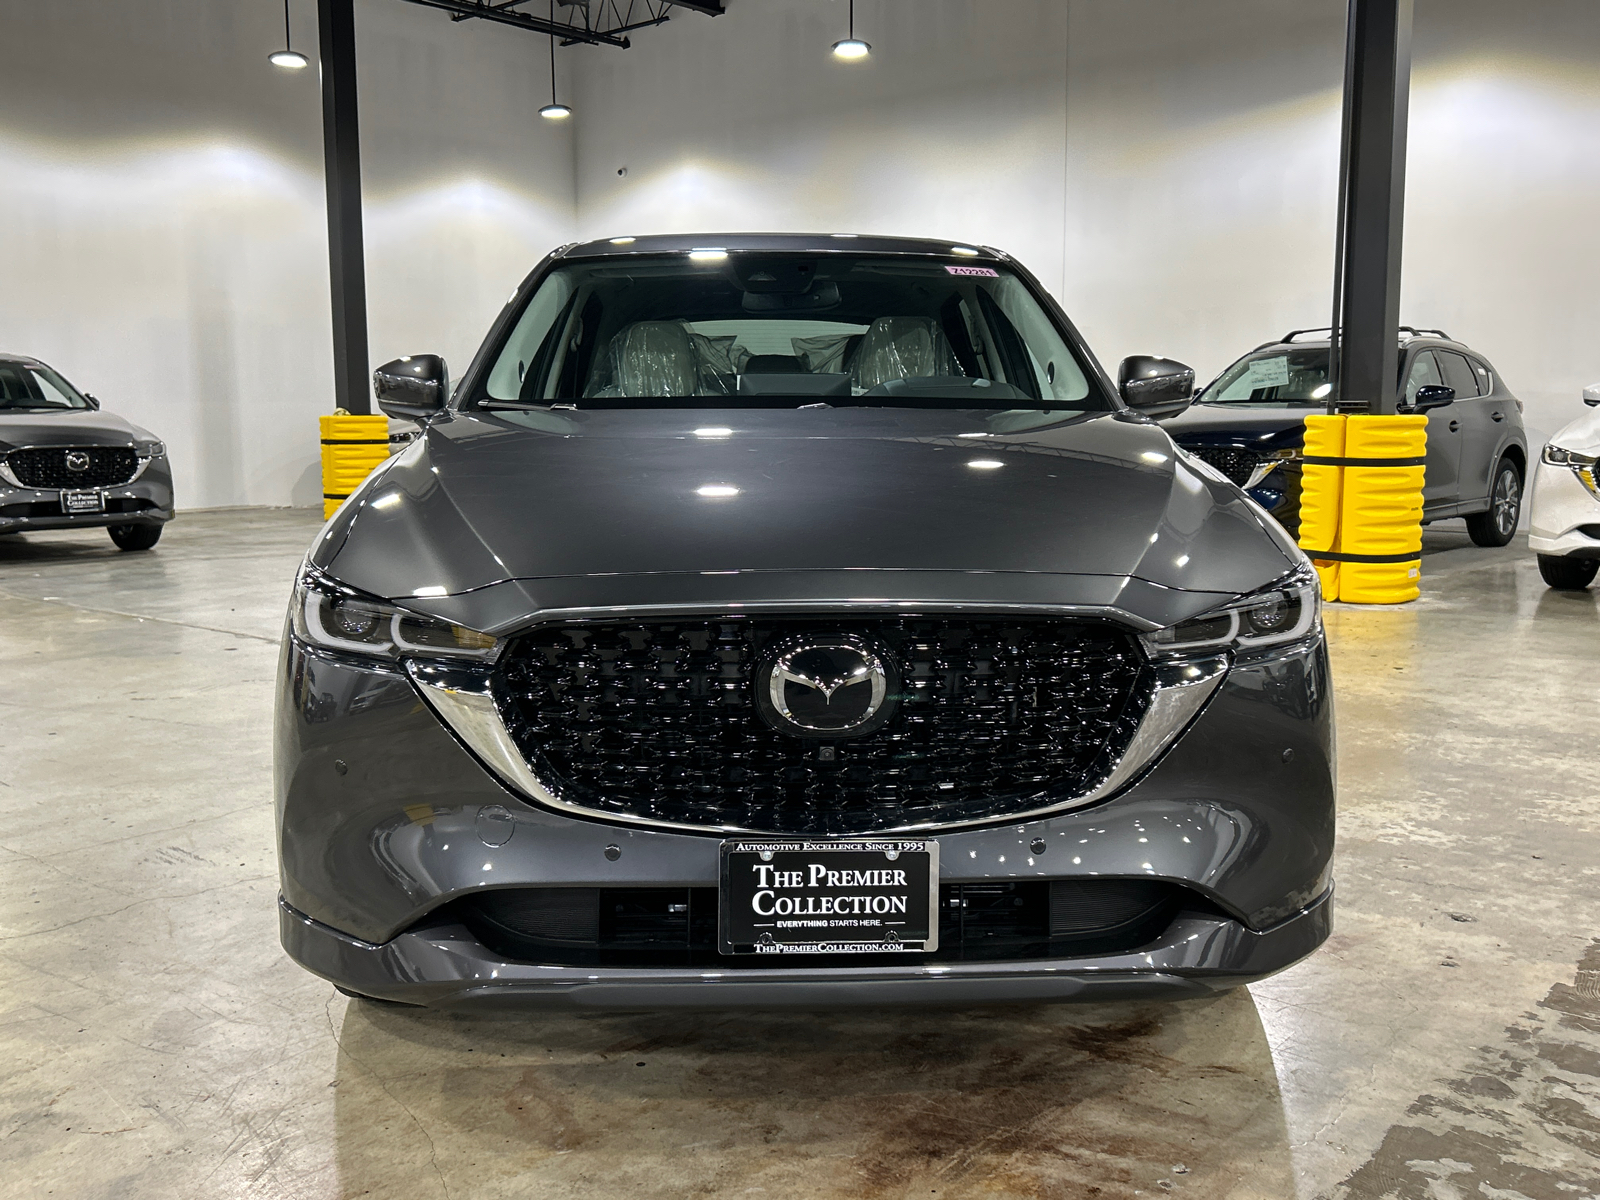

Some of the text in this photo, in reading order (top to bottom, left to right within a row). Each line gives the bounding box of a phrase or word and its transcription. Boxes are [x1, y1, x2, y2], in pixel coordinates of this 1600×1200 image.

[736, 842, 924, 851] AUTOMOTIVE EXCELLENCE SINCE 1995
[752, 863, 908, 888] THE PREMIER
[752, 890, 908, 916] COLLECTION
[776, 920, 828, 928] EVERYTHING
[859, 919, 883, 927] HERE.
